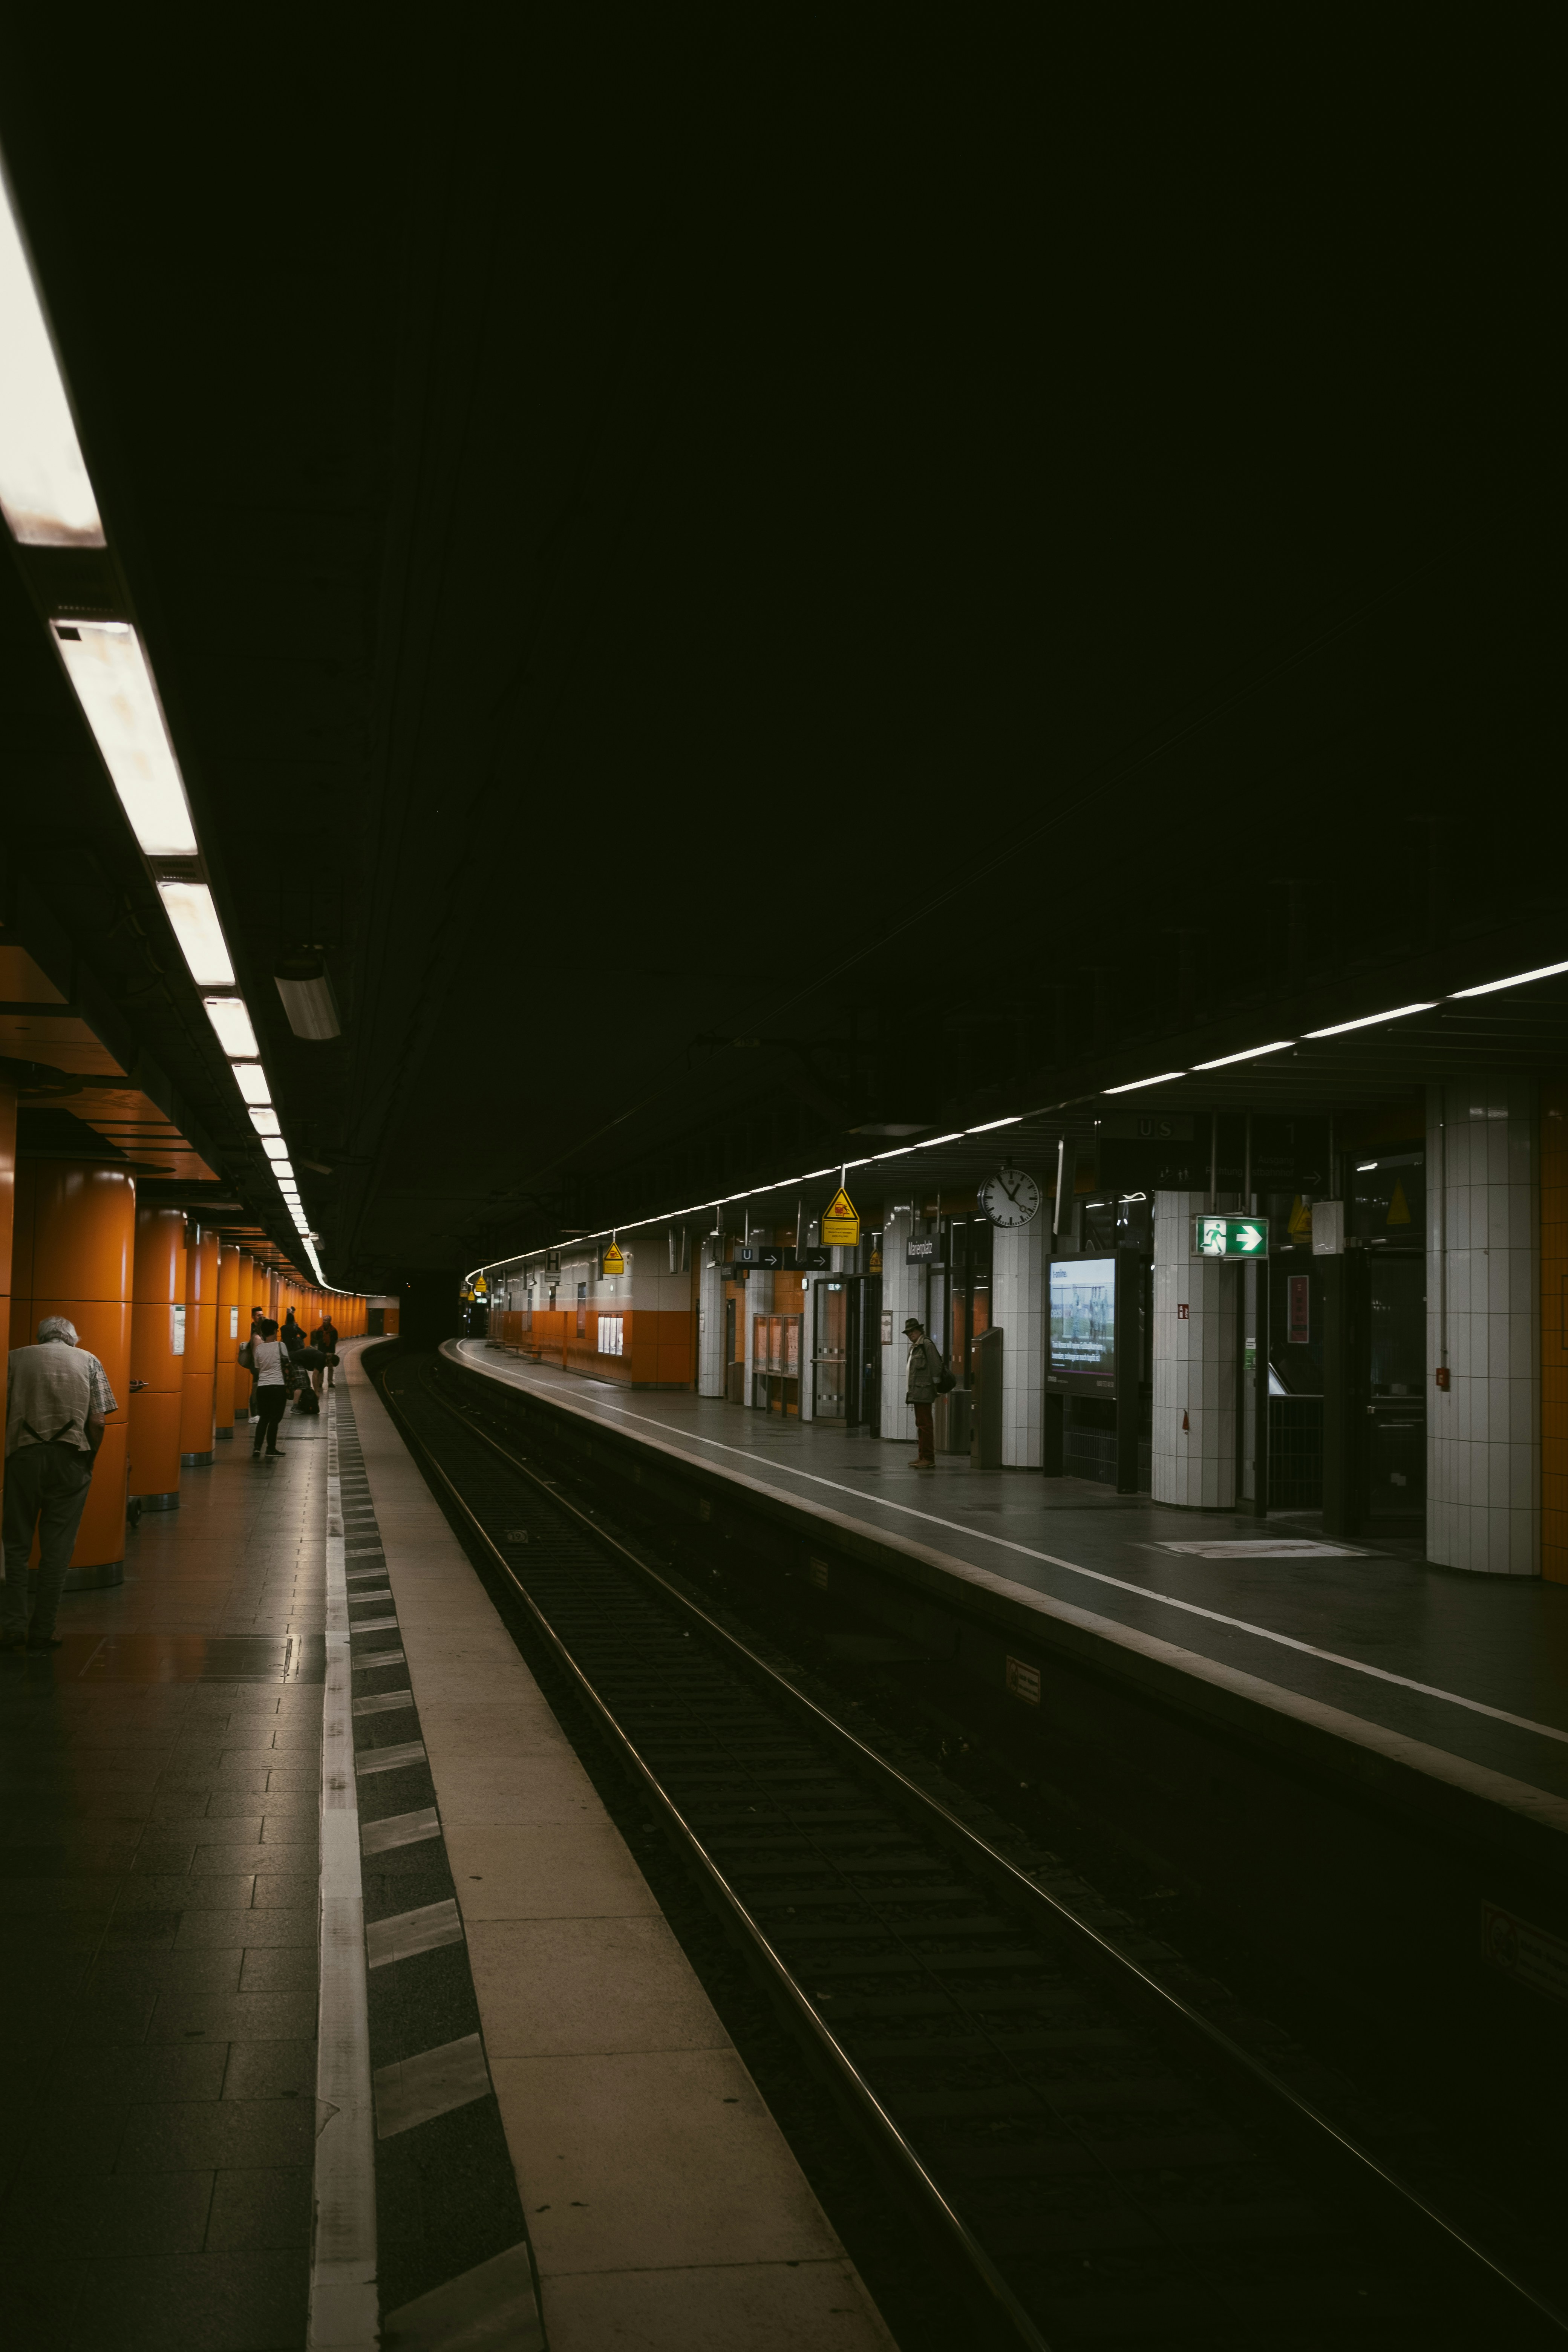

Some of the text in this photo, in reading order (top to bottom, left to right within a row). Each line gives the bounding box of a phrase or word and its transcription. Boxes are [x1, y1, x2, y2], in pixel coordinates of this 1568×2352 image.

[1141, 1120, 1171, 1136] U S
[1286, 1122, 1294, 1144] 1
[1257, 1155, 1294, 1166] Ausgang
[1252, 1168, 1295, 1176] stbahnhof
[743, 1250, 751, 1260] U
[908, 1240, 933, 1258] Marienplatz
[548, 1252, 559, 1271] H
